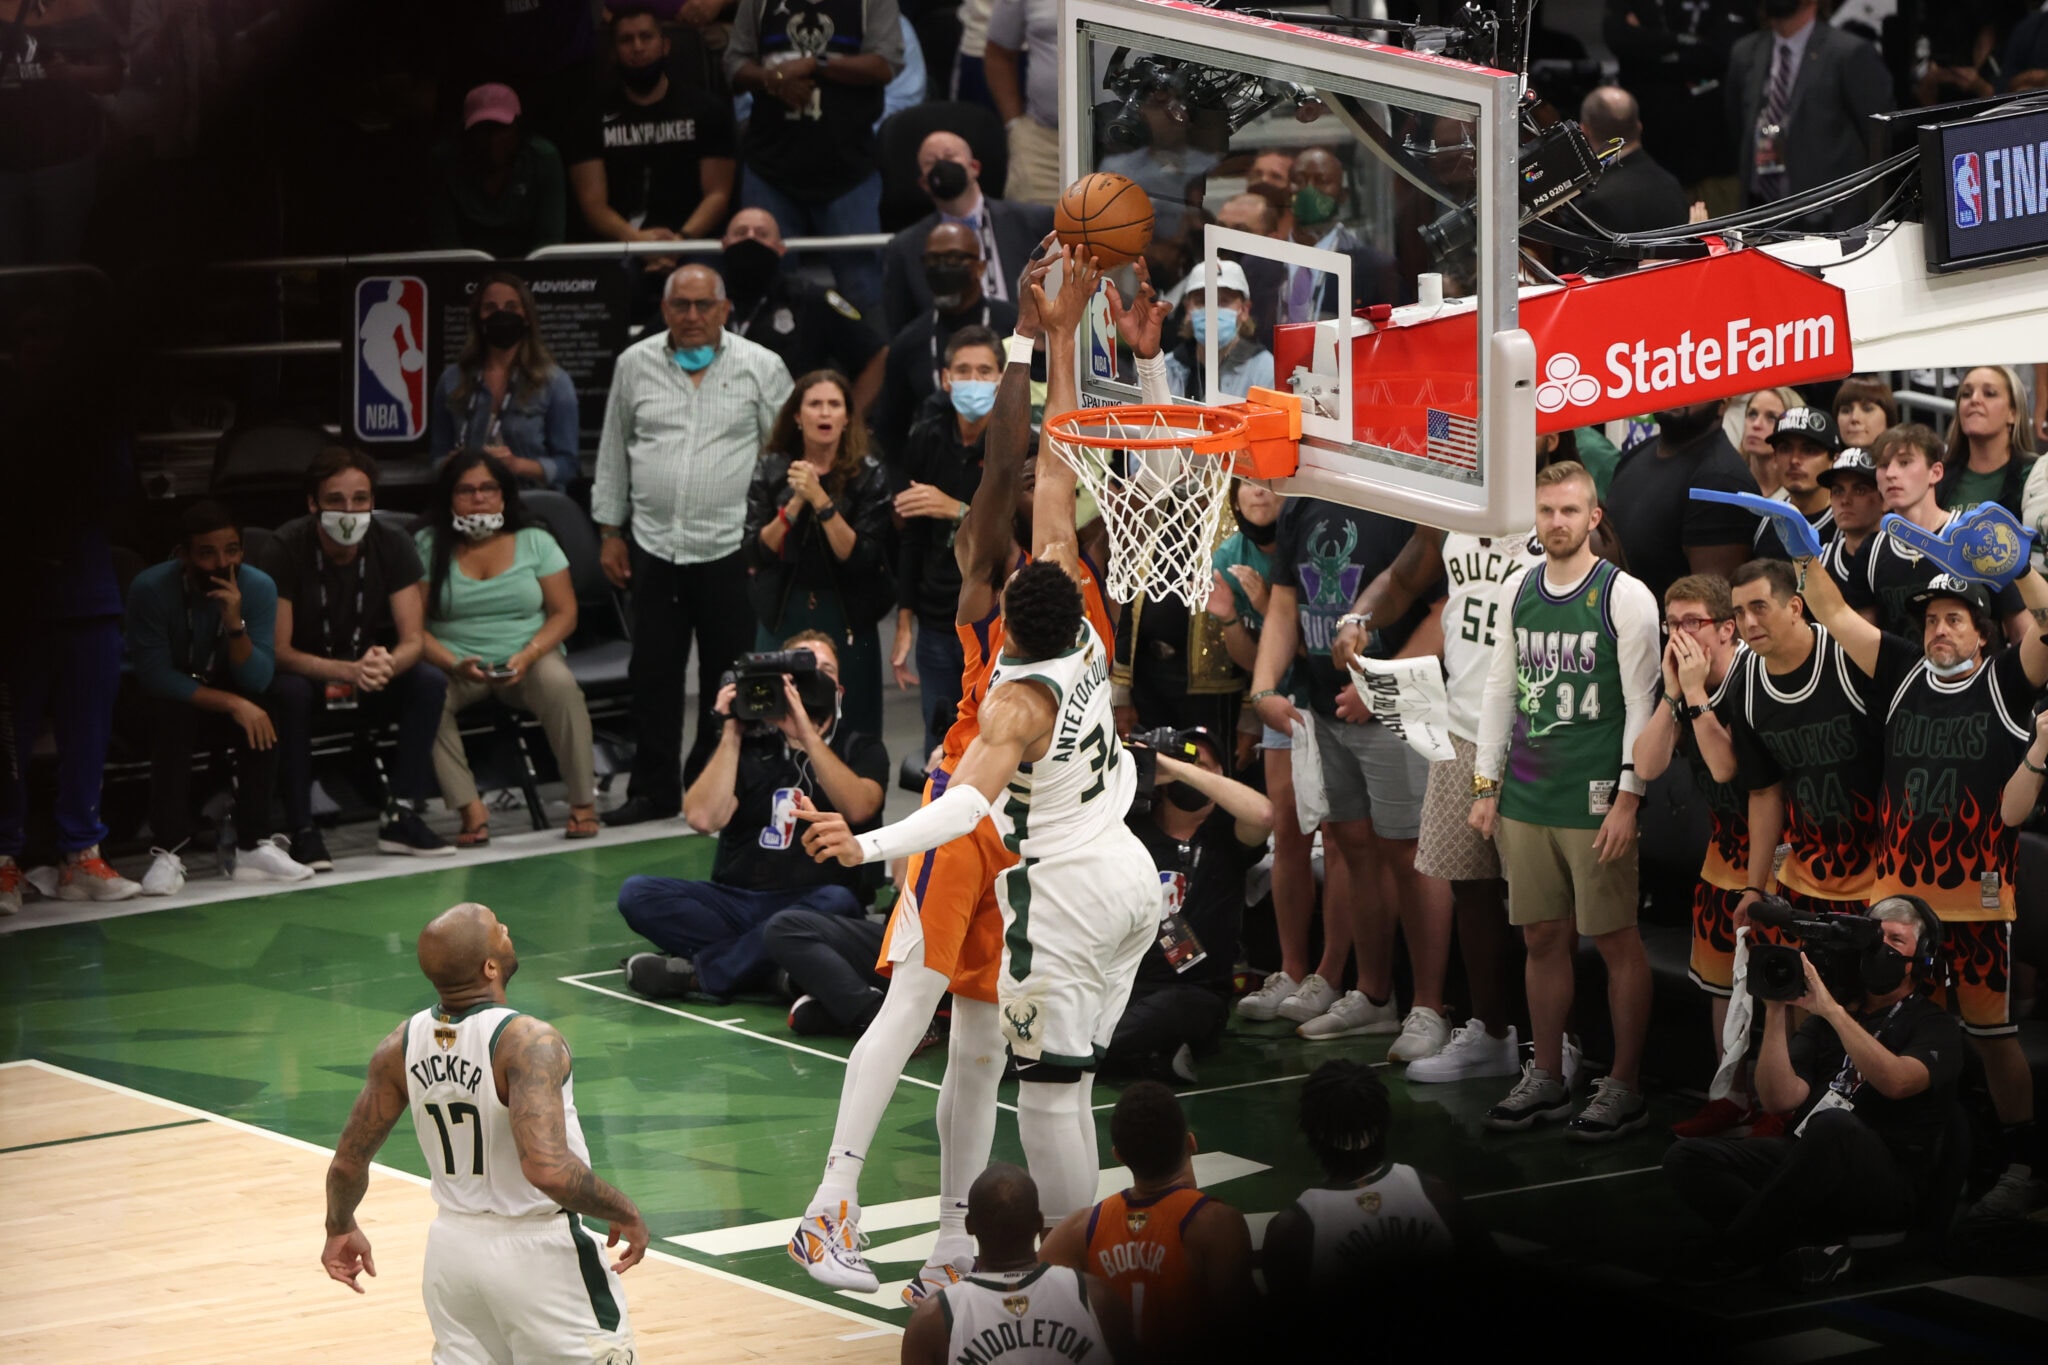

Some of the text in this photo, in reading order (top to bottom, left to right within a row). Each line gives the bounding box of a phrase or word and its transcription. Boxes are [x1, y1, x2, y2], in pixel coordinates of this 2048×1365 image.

[1549, 184, 1564, 197] 020
[531, 279, 598, 293] ADVISORY
[1094, 354, 1108, 373] NBA
[365, 403, 399, 431] NBA
[1515, 628, 1599, 673] BUCKS
[1556, 682, 1600, 720] 34
[1761, 714, 1858, 769] BUCKS
[1892, 709, 1990, 760] BUCKS
[1798, 772, 1852, 827] 34
[1902, 767, 1958, 822] 34
[410, 1055, 482, 1094] TUCKER
[425, 1102, 483, 1175] 17
[1098, 1240, 1166, 1279] BOOKER
[1131, 1281, 1145, 1342] 1
[957, 1319, 1093, 1365] MIDDLETON
